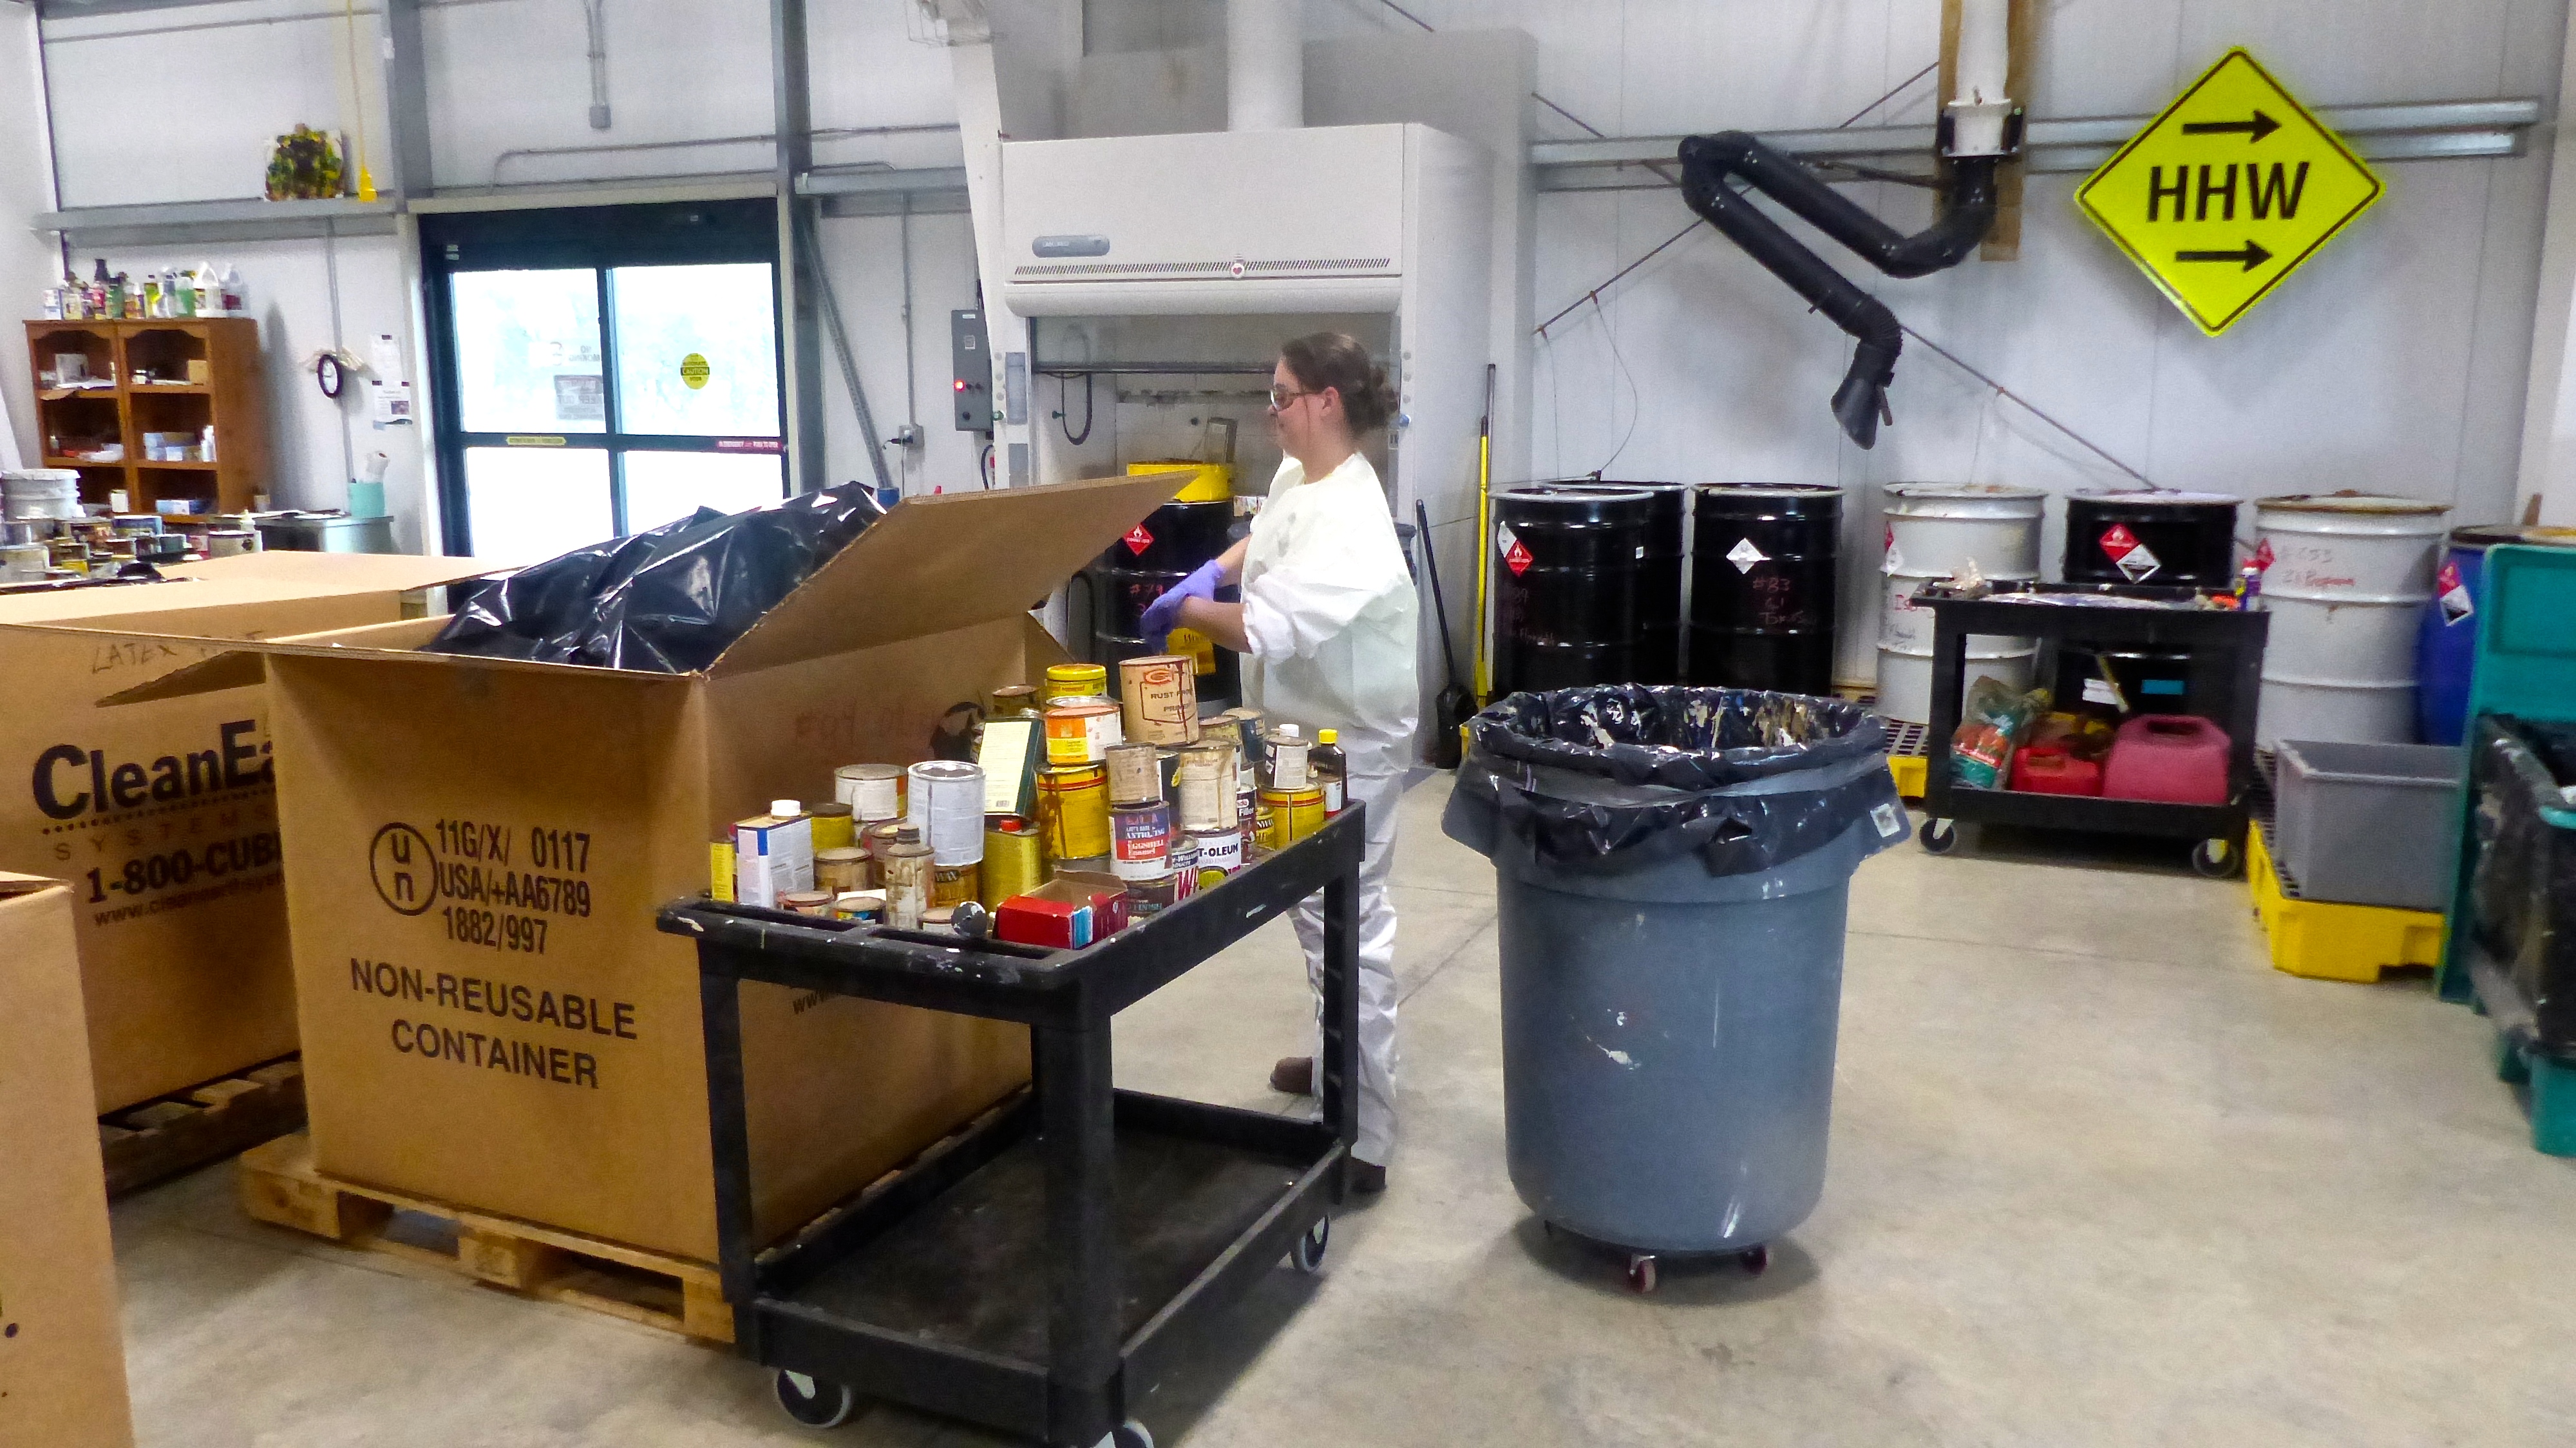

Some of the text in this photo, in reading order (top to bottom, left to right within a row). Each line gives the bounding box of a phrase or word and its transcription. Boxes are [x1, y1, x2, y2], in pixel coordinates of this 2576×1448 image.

[2146, 162, 2310, 222] HHW
[92, 642, 178, 674] LATEX
[531, 826, 591, 873] 0117
[442, 906, 548, 955] 1882/997
[350, 957, 638, 1041] NON-REUSABLE
[390, 1018, 600, 1090] CONTAINER
